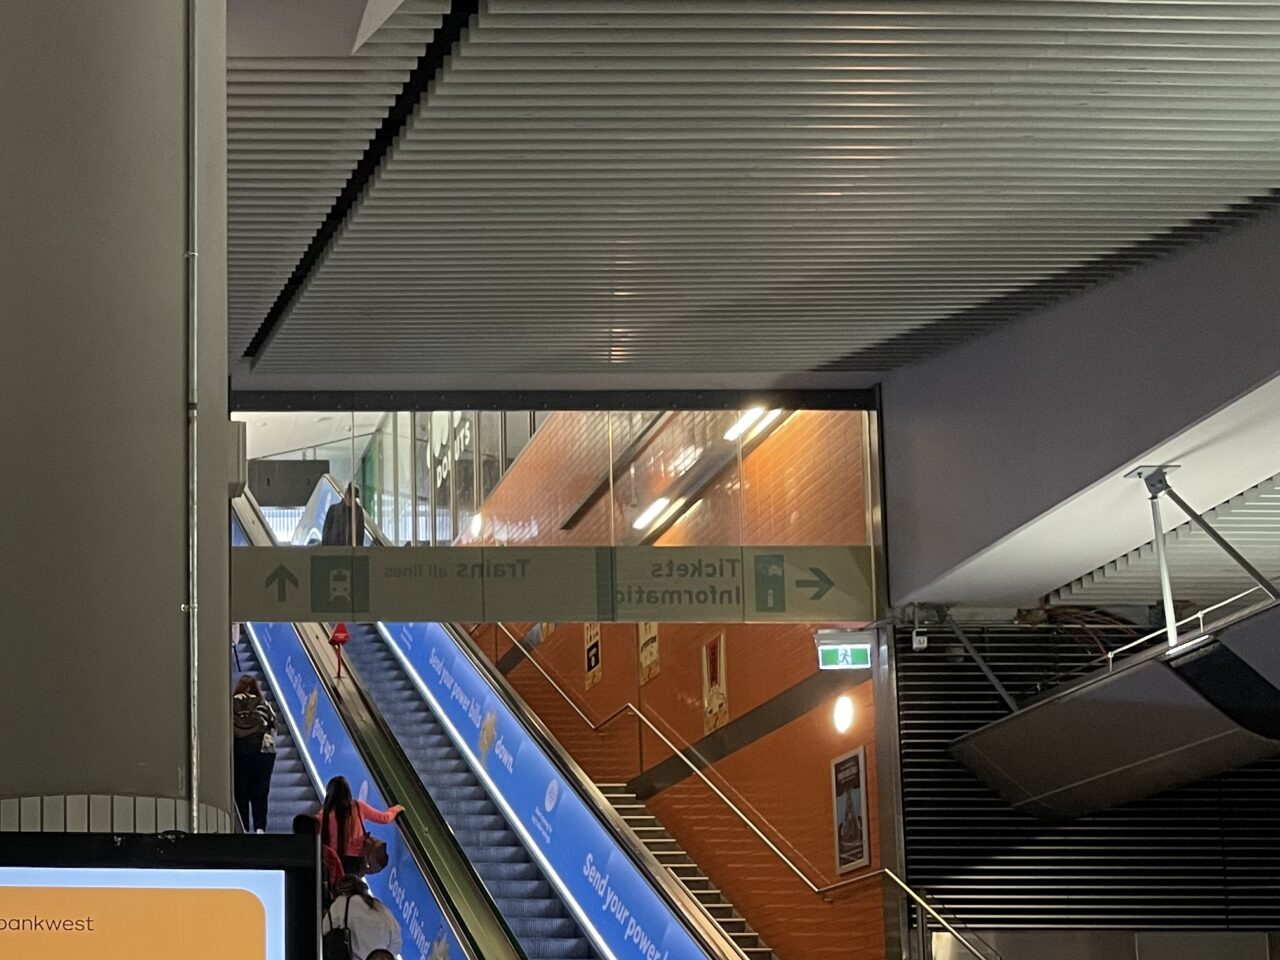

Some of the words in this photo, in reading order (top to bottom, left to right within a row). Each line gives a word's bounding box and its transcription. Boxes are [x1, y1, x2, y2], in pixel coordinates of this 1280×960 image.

[388, 867, 406, 911] Cost
[403, 899, 417, 925] of
[583, 852, 609, 897] Send
[602, 887, 629, 925] your
